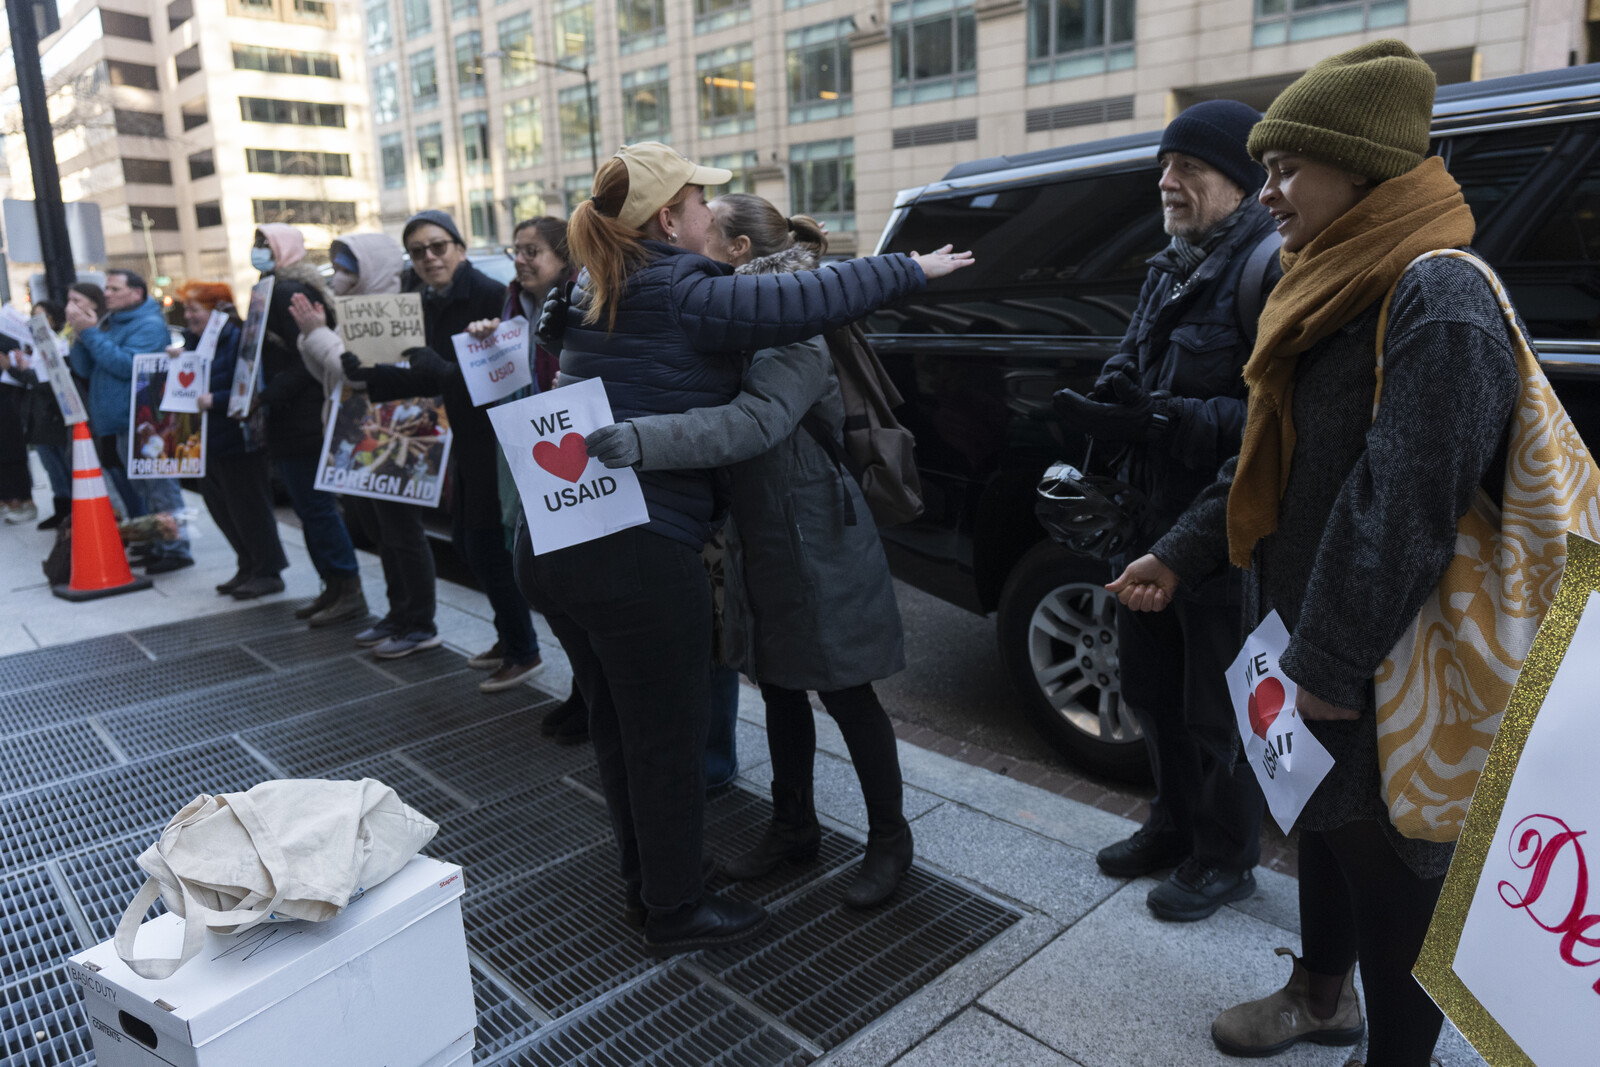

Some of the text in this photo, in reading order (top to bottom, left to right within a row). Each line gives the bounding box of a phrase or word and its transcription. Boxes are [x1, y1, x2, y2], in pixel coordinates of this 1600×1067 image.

[340, 297, 419, 320] THANK YOU
[343, 318, 424, 341] USAID BHA
[501, 328, 521, 341] YOU
[530, 409, 573, 437] WE
[132, 458, 201, 474] FOREIGN AID
[324, 466, 435, 500] FOREIGN AID
[543, 476, 617, 512] USAID
[1245, 652, 1269, 688] WE
[439, 875, 459, 888] Staples
[71, 968, 117, 1002] BASIC DUTY
[92, 1019, 122, 1043] CONTENTS:
